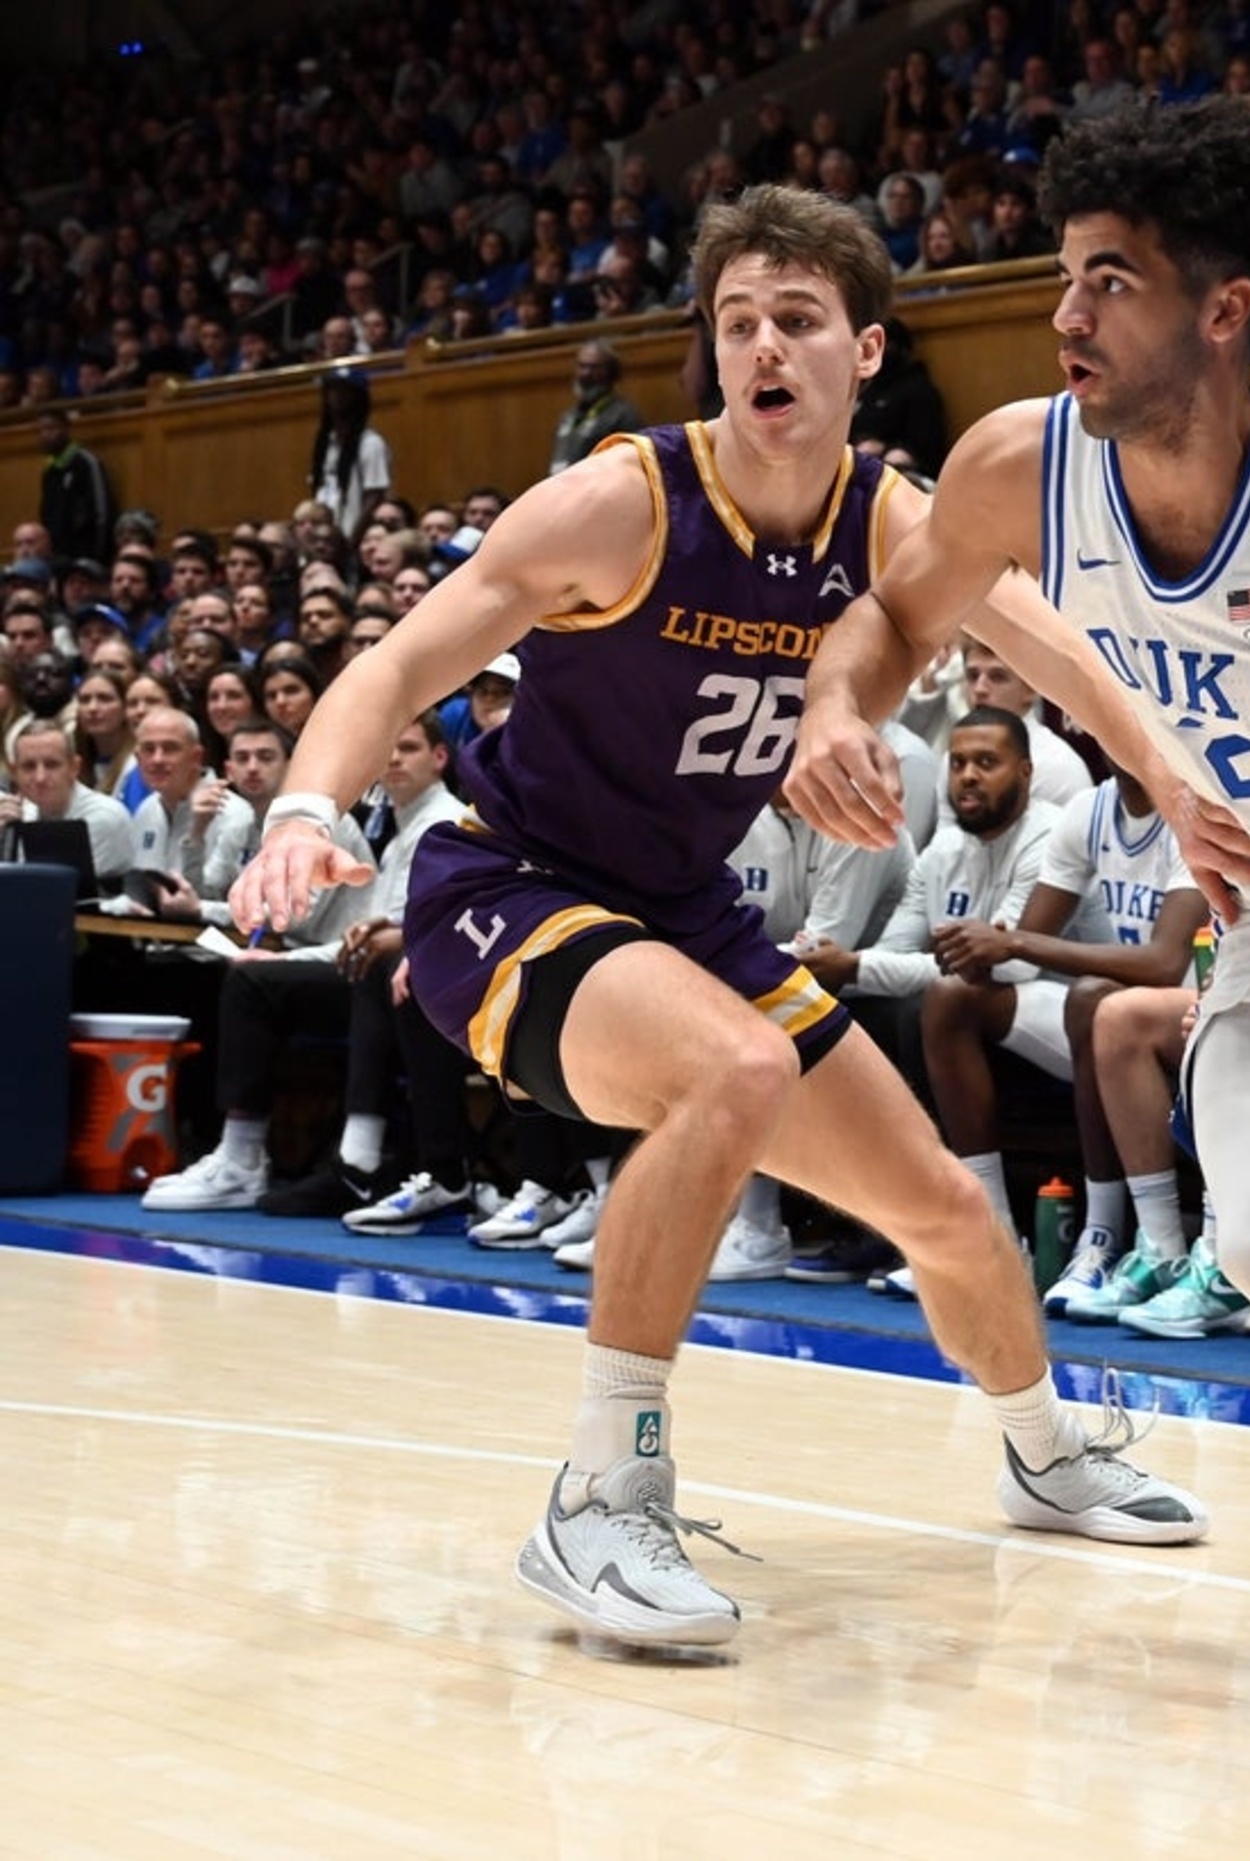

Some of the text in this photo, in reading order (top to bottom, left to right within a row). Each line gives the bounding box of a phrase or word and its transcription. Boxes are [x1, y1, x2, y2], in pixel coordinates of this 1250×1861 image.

[674, 673, 807, 777] 26
[454, 908, 507, 960] L
[126, 1064, 167, 1112] G
